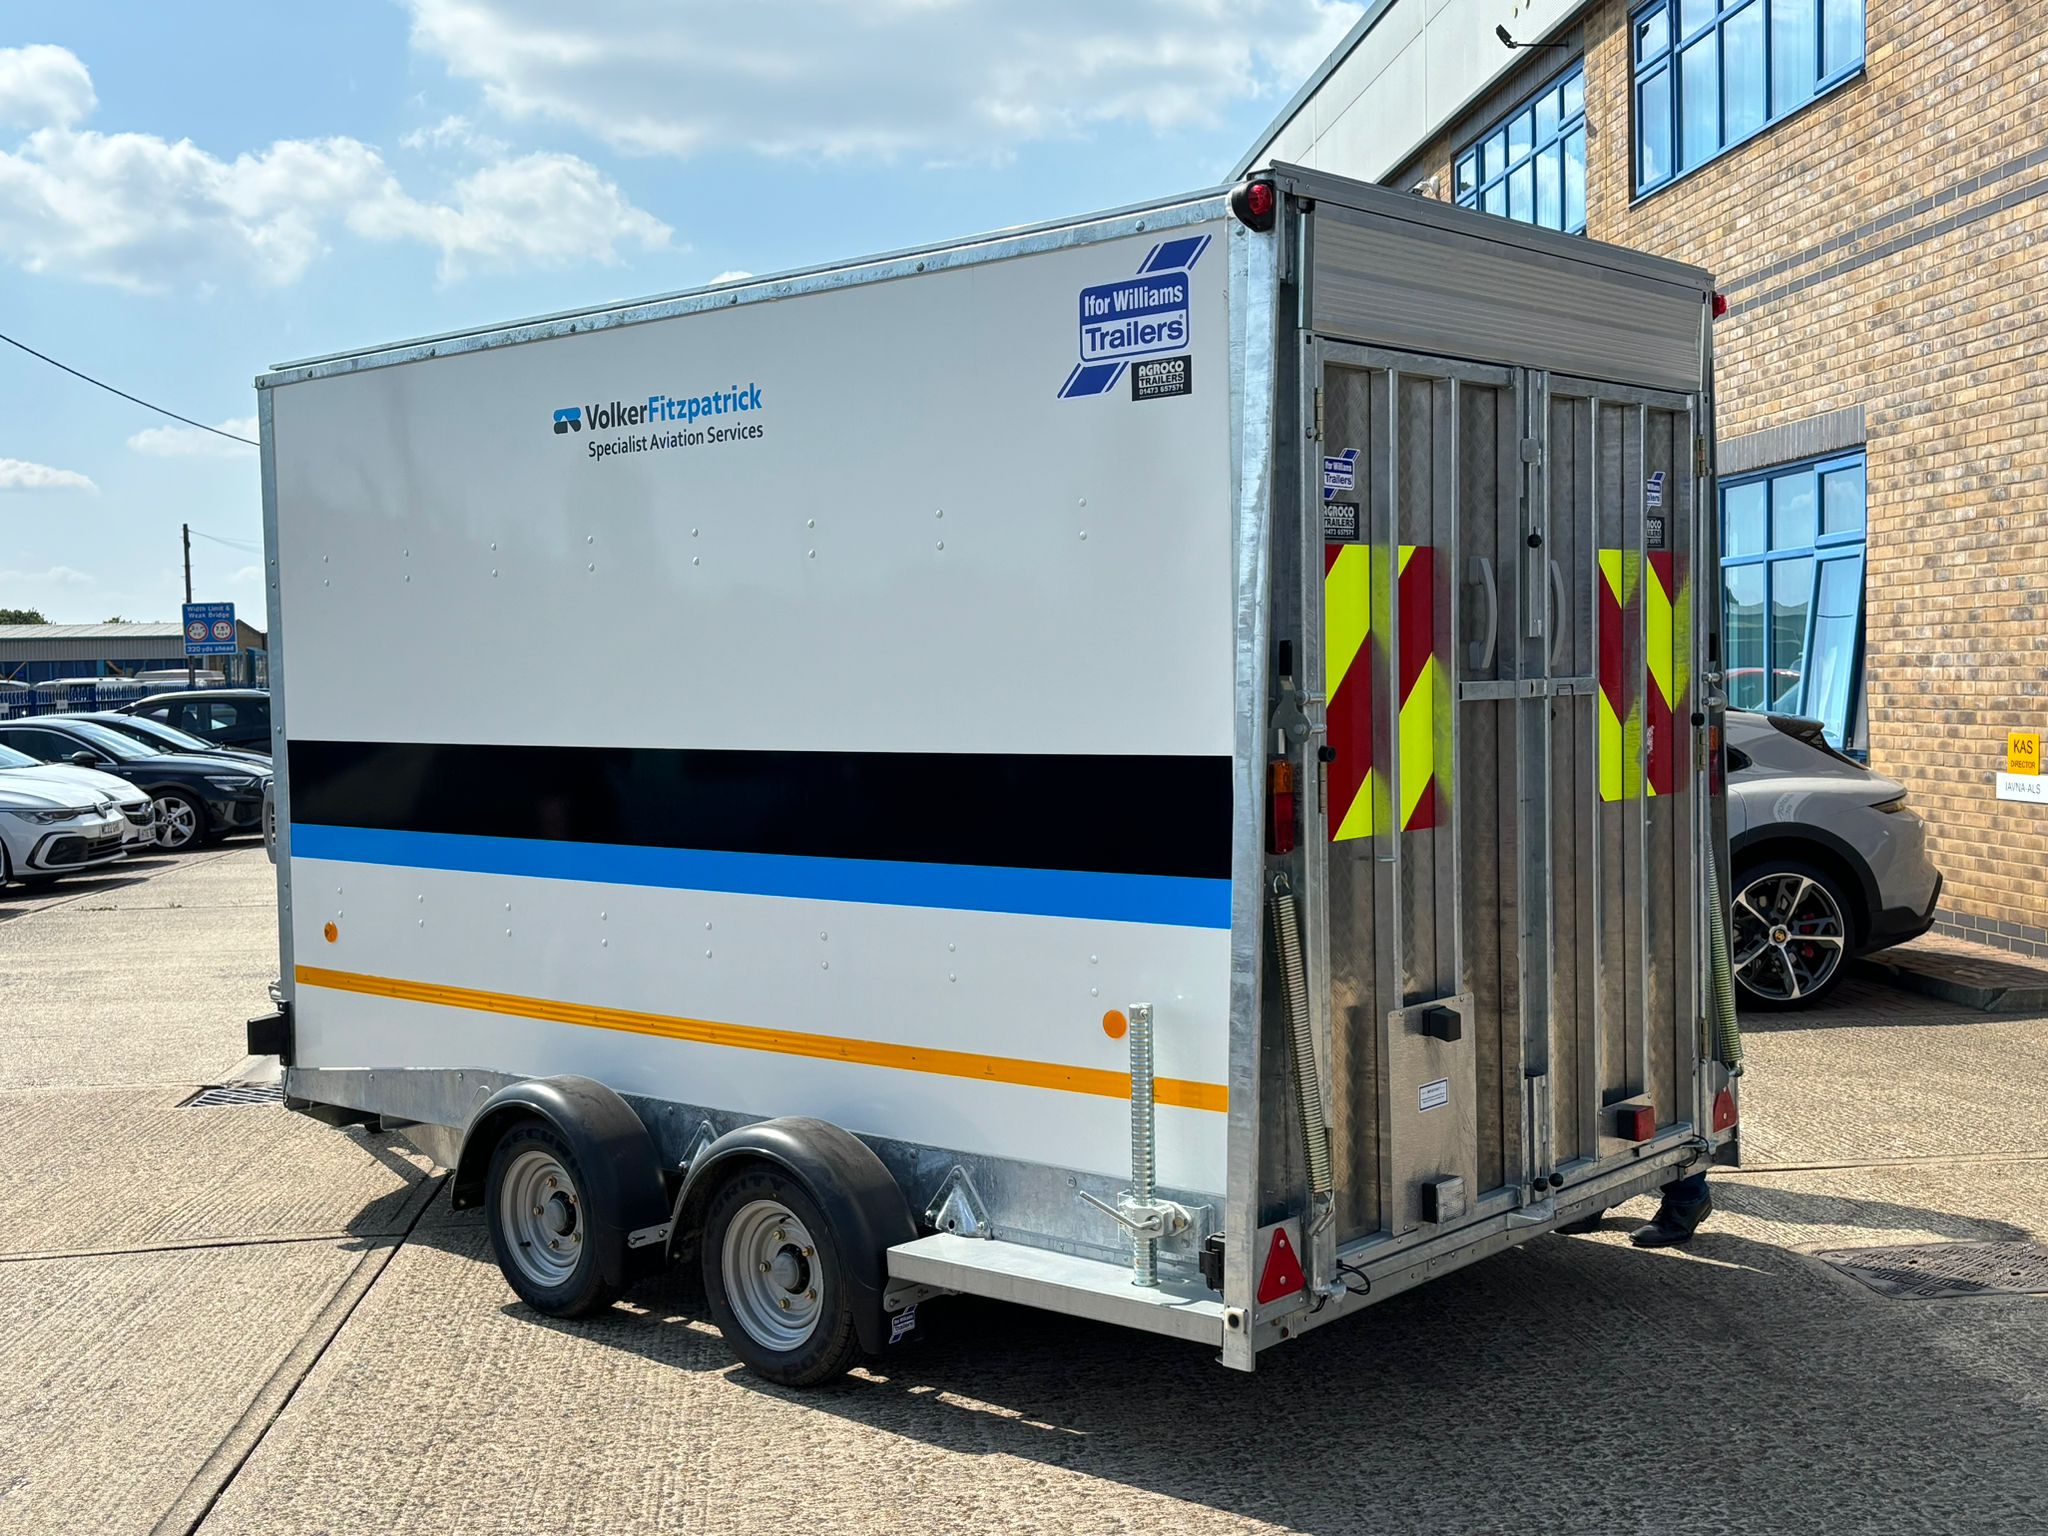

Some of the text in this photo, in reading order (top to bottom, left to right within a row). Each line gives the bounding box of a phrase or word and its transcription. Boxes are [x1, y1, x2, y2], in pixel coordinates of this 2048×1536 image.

[1084, 285, 1183, 317] Ifor Williams
[1085, 319, 1184, 352] Trailers
[1138, 360, 1185, 377] AGROCO
[1139, 373, 1184, 388] TRAILERS
[1139, 385, 1159, 395] 01473
[585, 383, 763, 431] VolkerFitzpatrick
[588, 422, 764, 461] Specialist Aviation Services
[1325, 473, 1352, 486] Trailers
[2013, 739, 2034, 754] KAS
[2010, 760, 2036, 769] DIRECTOR
